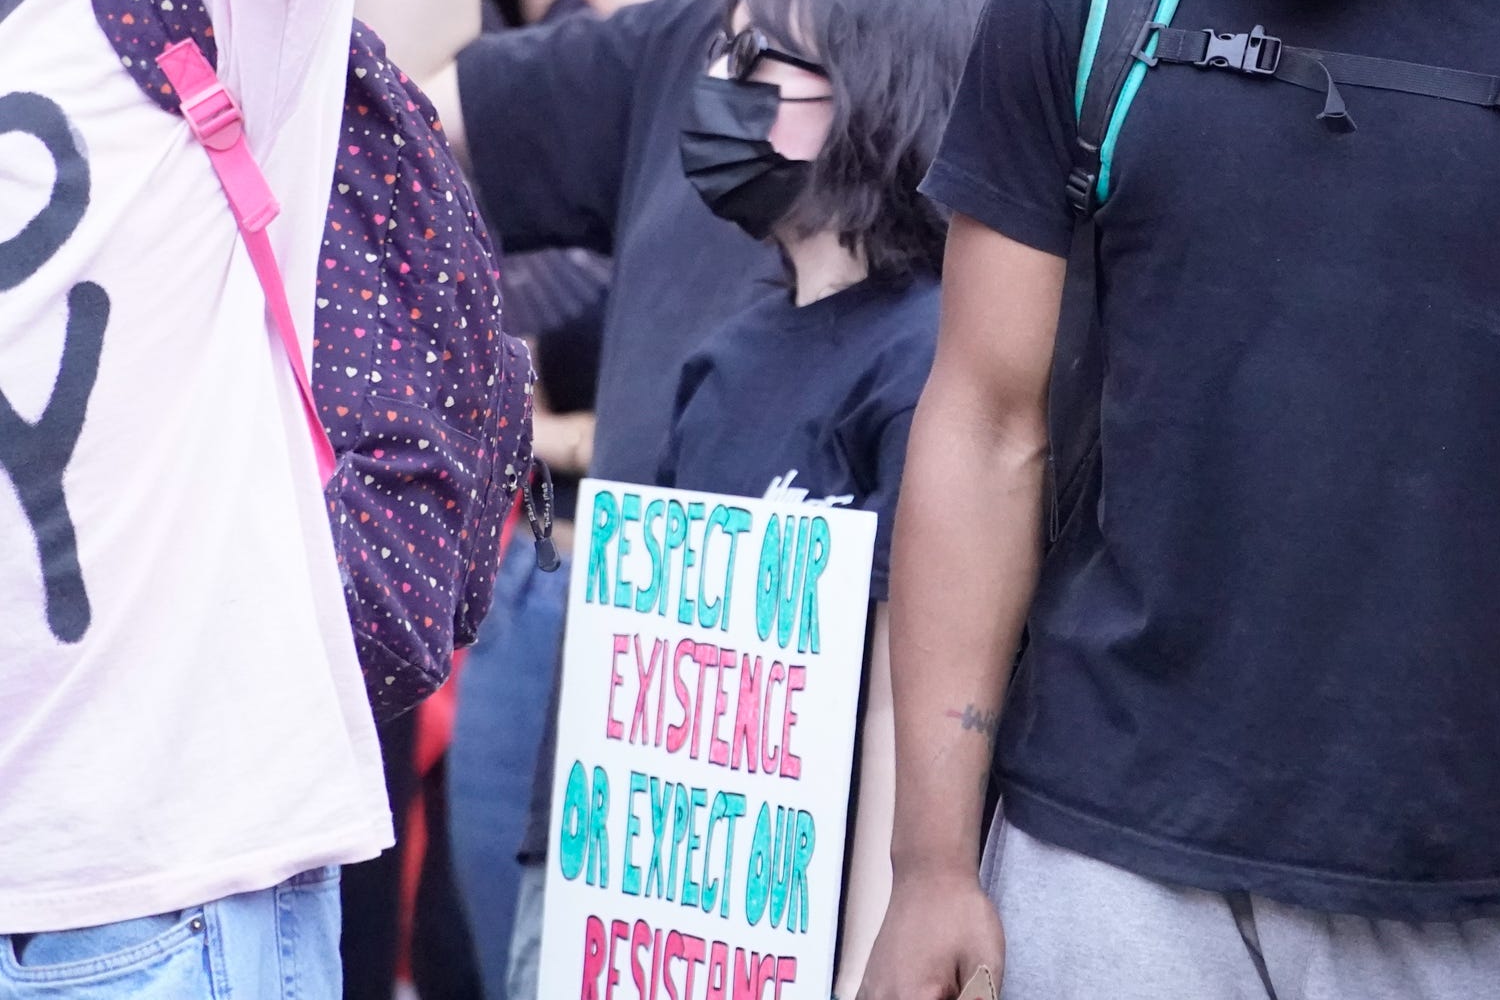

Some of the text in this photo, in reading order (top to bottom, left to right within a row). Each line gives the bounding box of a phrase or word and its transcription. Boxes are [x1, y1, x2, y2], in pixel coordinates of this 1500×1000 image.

[585, 489, 831, 654] RESPECT OUR
[605, 631, 807, 780] EXISTENCE
[559, 759, 816, 934] OR EXPECT OUR
